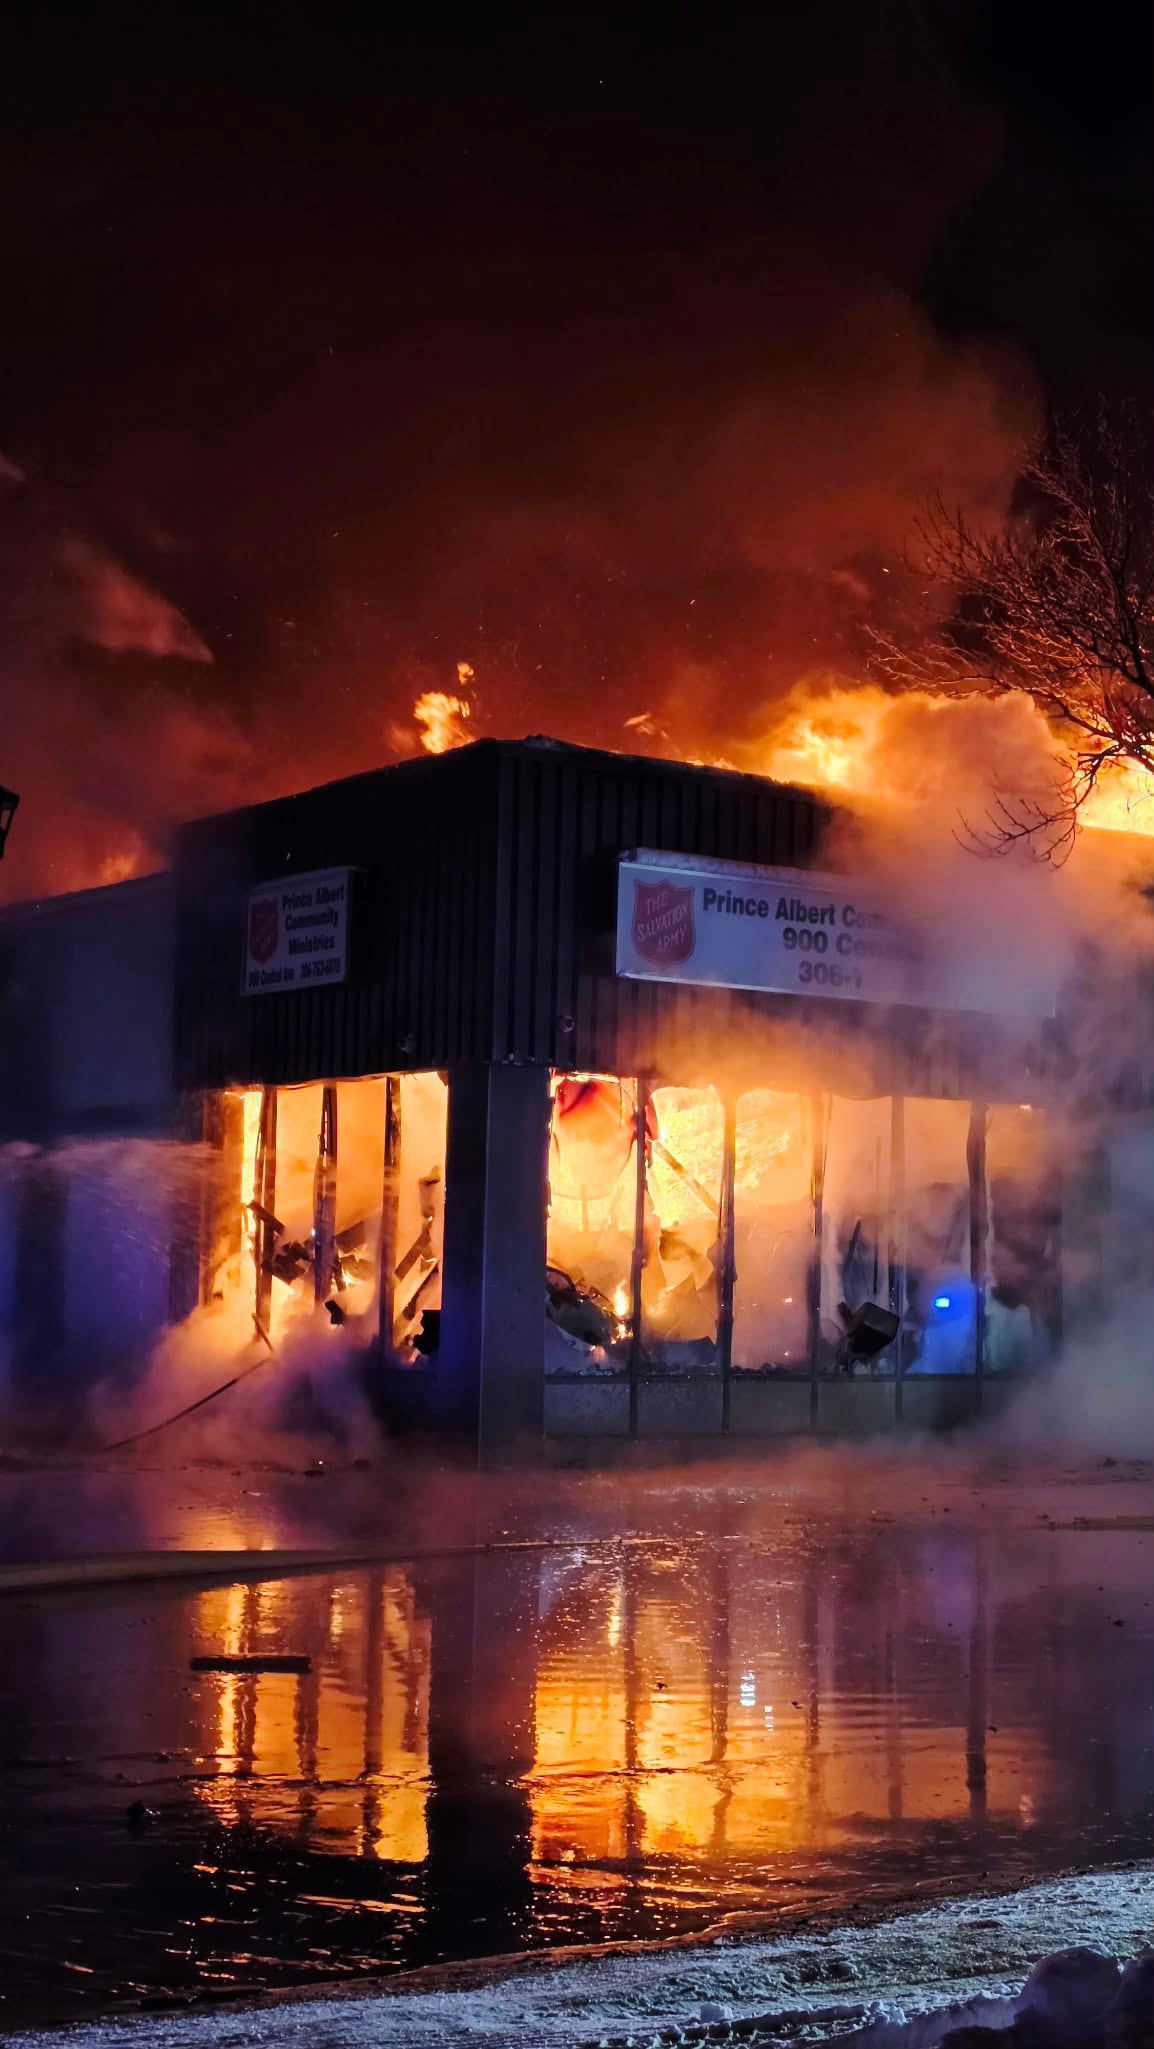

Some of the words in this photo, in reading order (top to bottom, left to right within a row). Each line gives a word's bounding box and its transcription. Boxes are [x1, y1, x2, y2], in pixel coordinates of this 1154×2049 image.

[315, 883, 345, 905] Albert
[645, 892, 669, 915] THE
[703, 887, 769, 918] Prince
[775, 897, 836, 926] Albert
[636, 902, 689, 944] SALVATION
[783, 926, 828, 954] 900
